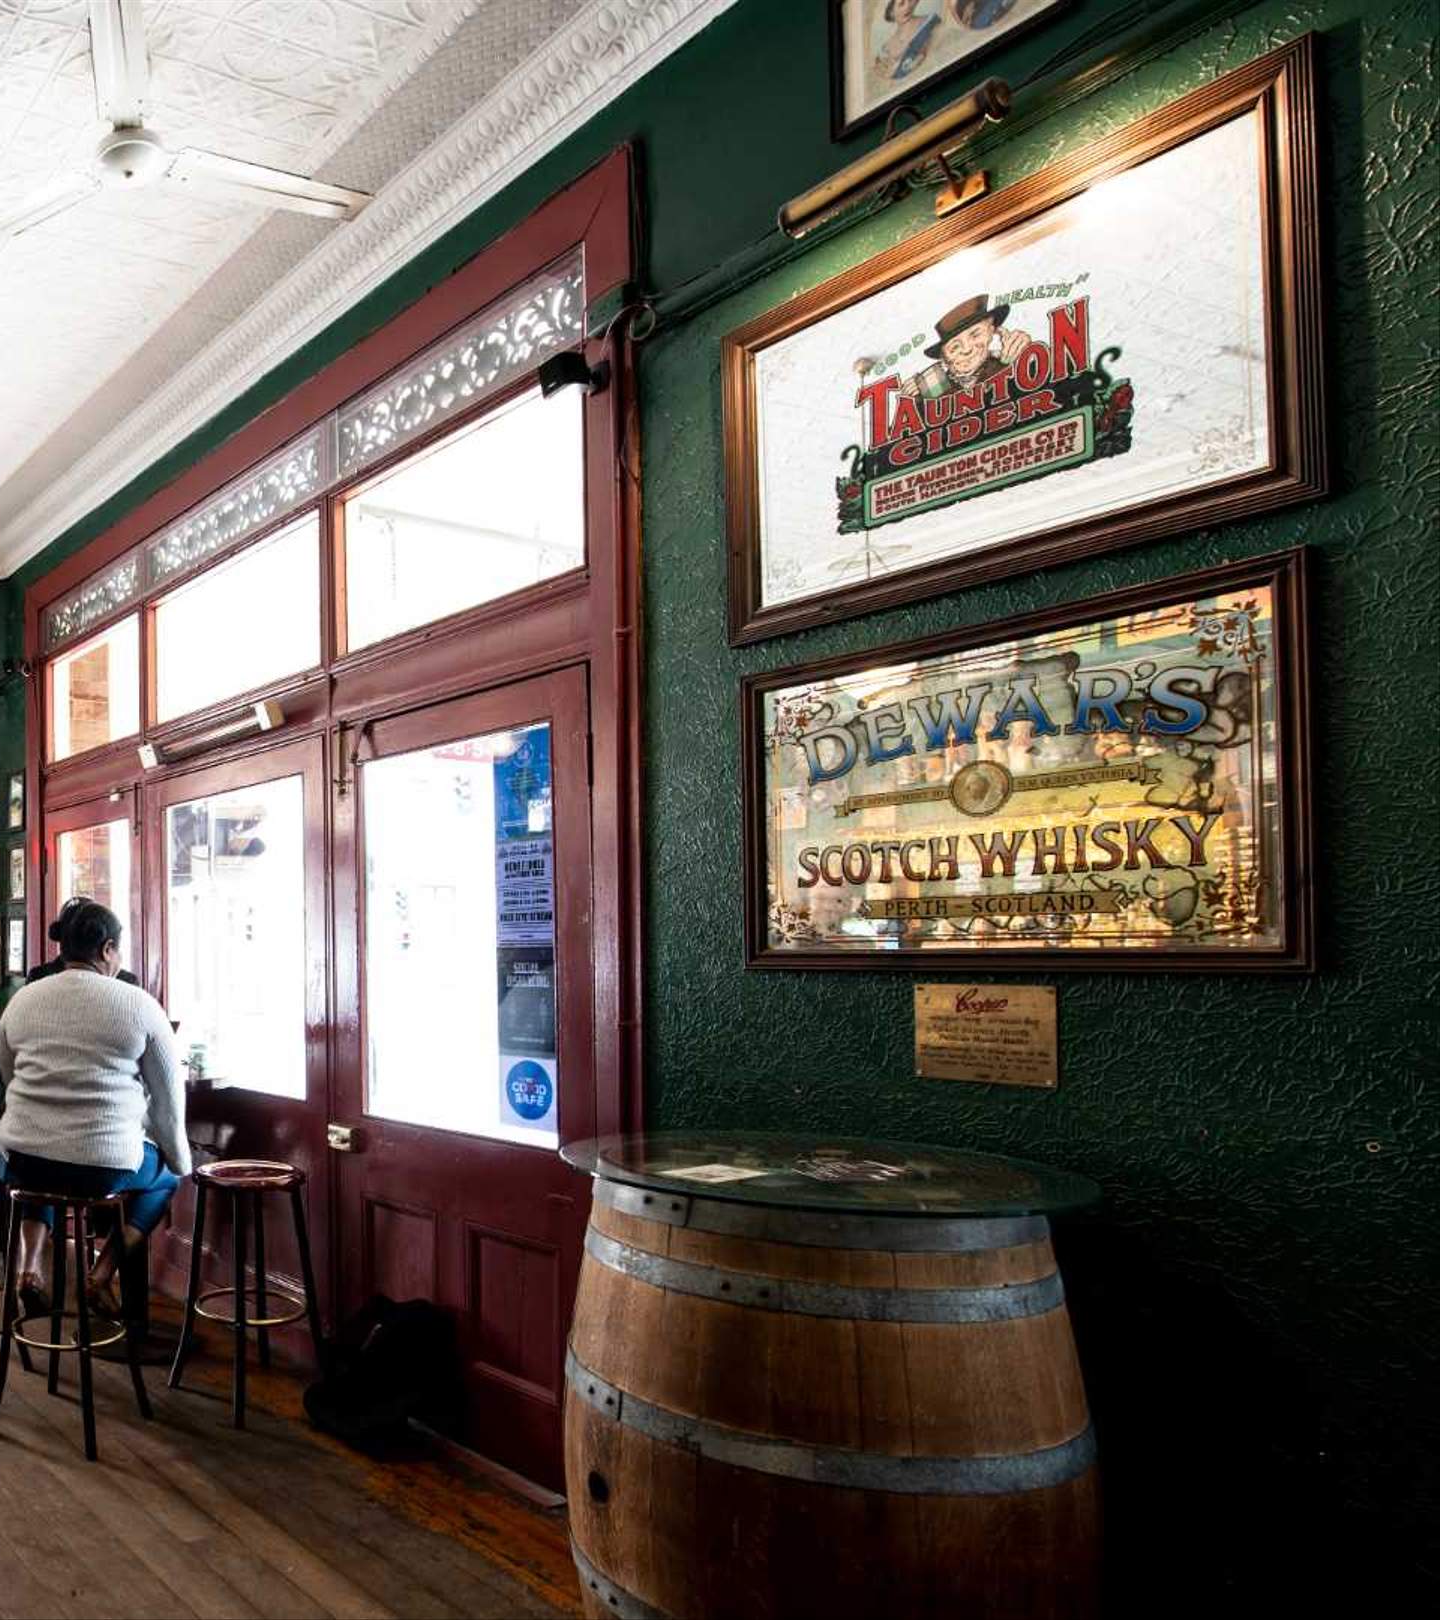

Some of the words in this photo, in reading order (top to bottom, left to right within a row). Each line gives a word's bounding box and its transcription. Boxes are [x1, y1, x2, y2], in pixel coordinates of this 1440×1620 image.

[855, 296, 1091, 451] TAUNTON
[889, 388, 1063, 466] CIDER
[875, 480, 902, 496] THE
[904, 454, 978, 486] TAUNTON
[980, 438, 1032, 464] CIDER
[799, 663, 1224, 785] DEWAR'S
[797, 835, 960, 888] SCOTCH
[968, 813, 1225, 879] WHISKY
[884, 897, 949, 917] PERTH
